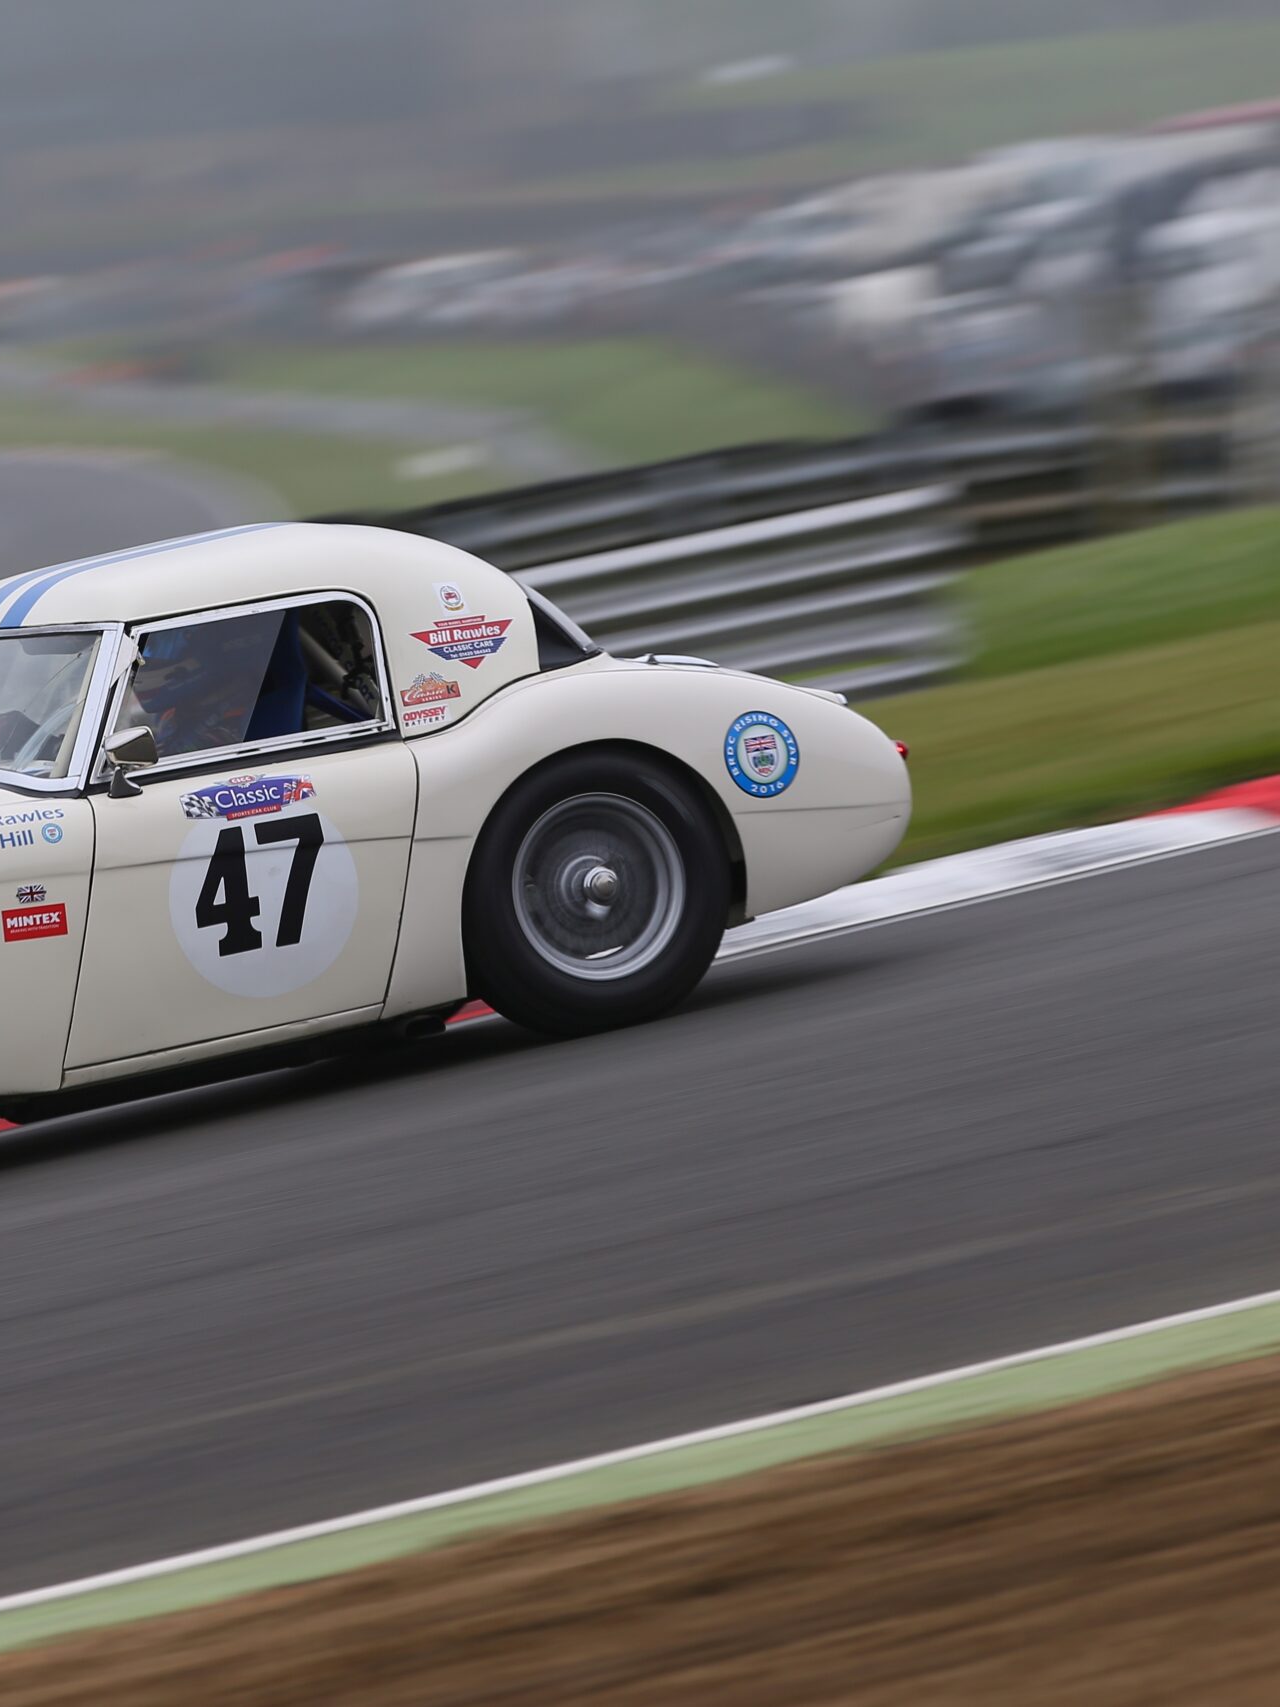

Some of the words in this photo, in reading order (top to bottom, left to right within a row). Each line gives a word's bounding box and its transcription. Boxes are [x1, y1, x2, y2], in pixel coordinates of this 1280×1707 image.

[429, 629, 451, 645] Bill
[453, 625, 501, 641] Rawles
[443, 642, 474, 653] CLASSIC
[473, 640, 494, 648] CARS
[403, 706, 446, 721] ODYSSEY
[405, 716, 445, 727] BATTERY
[733, 714, 779, 732] RISING
[727, 735, 740, 776] BRDC
[781, 729, 797, 765] STAR
[215, 784, 280, 808] Classic
[0, 829, 34, 849] Hill
[195, 812, 324, 957] 47
[6, 911, 61, 929] MINTEX
